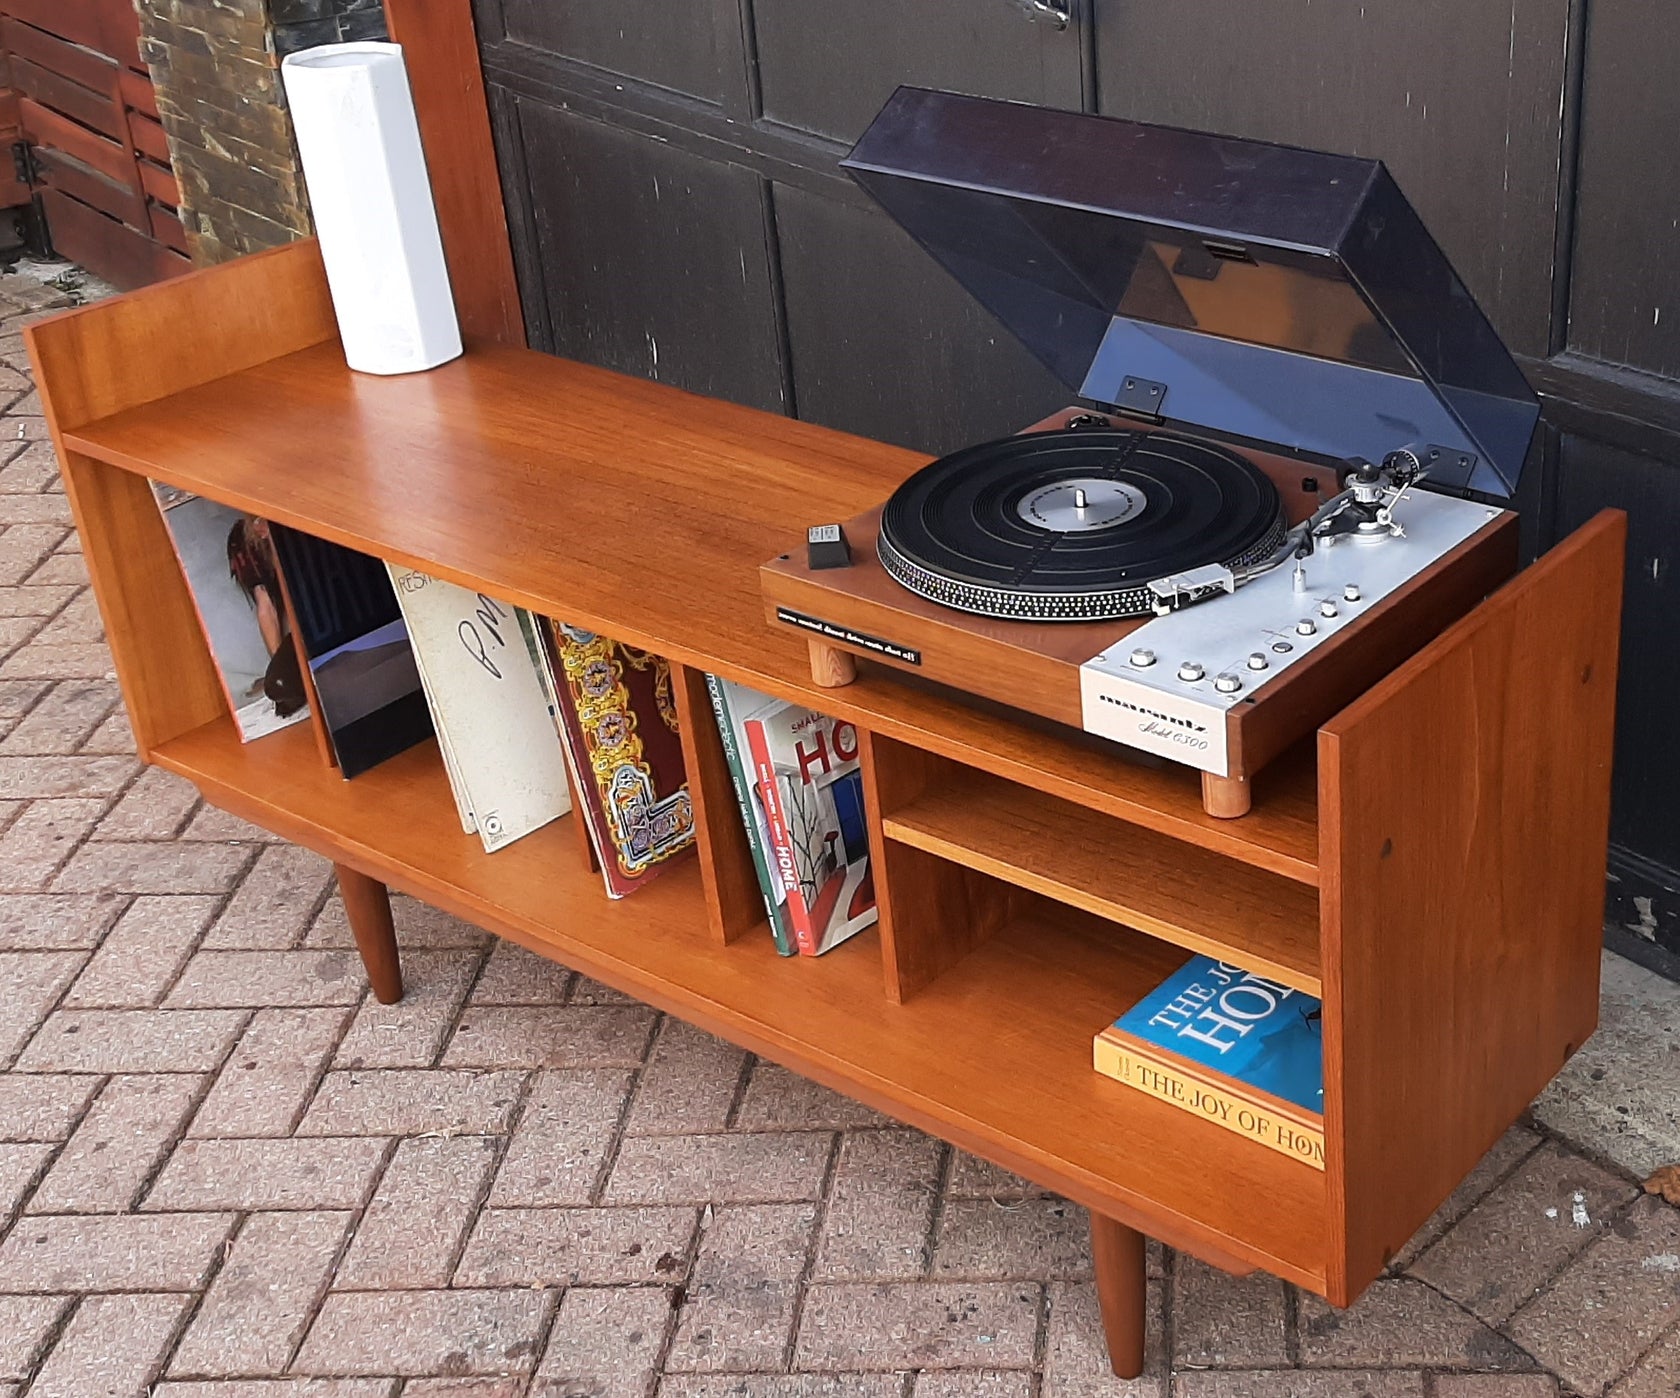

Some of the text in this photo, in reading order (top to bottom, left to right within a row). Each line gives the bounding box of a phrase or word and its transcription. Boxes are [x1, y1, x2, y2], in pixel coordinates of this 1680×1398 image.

[791, 711, 825, 734] SMALL
[795, 719, 859, 786] HO
[775, 845, 798, 891] HOME
[1148, 982, 1217, 1030] THE
[1137, 1064, 1184, 1102] THE
[1189, 1090, 1234, 1122] JOY
[1238, 1110, 1271, 1136] OF
